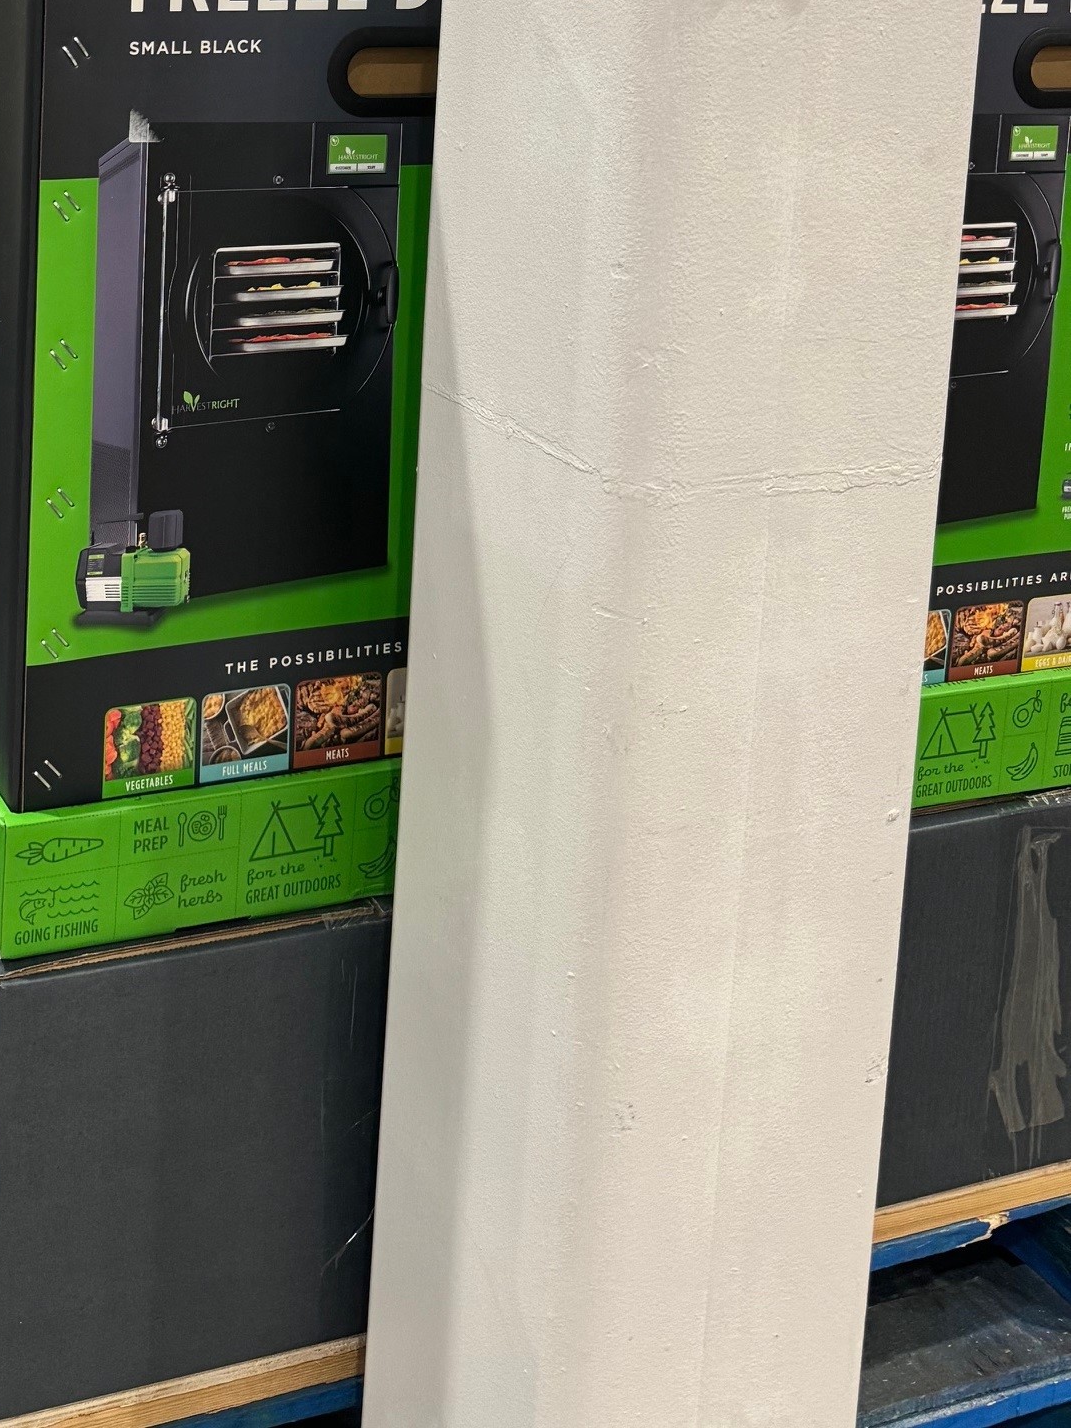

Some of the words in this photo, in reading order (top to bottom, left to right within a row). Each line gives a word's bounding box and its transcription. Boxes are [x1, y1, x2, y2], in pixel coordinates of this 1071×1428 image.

[129, 40, 192, 56] SMALL
[200, 38, 262, 55] BLACK
[937, 574, 1043, 597] POSSIBILITIES
[226, 659, 259, 676] THE
[269, 641, 403, 669] POSSIBILITIES
[974, 665, 993, 676] MEATS
[325, 748, 349, 761] MEATS
[222, 765, 240, 776] FULL
[242, 760, 267, 773] MEALS
[917, 765, 941, 782] for
[944, 762, 964, 774] the
[125, 774, 174, 792] VEGETABLES
[916, 781, 942, 799] GREAT
[944, 775, 992, 795] OUTDOORS
[133, 816, 170, 836] MEAL
[133, 834, 168, 855] PREP
[180, 868, 227, 893] fresh
[247, 865, 272, 887] for
[275, 860, 306, 876] the
[177, 888, 224, 910] herbs
[245, 881, 281, 905] GREAT
[283, 873, 342, 900] OUTDOORS
[15, 921, 51, 946] GOING
[53, 918, 99, 941] FISHING
